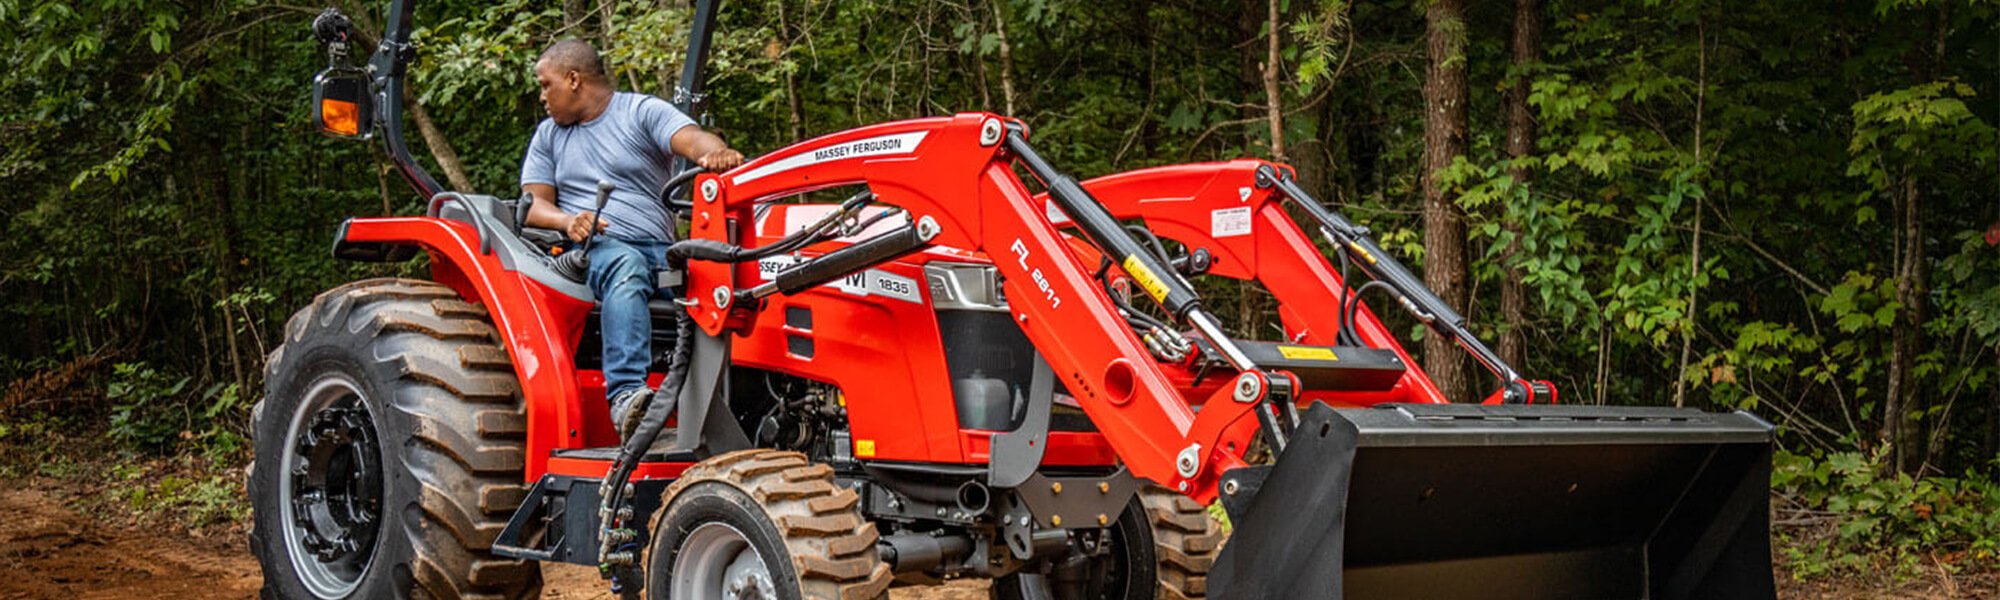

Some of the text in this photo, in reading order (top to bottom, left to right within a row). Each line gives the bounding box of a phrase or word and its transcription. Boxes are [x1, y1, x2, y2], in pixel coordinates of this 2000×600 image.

[814, 139, 902, 161] MASSEY FERGUSON
[760, 261, 784, 273] SSEY
[1010, 238, 1060, 309] FL 2811
[879, 279, 909, 294] 1835
